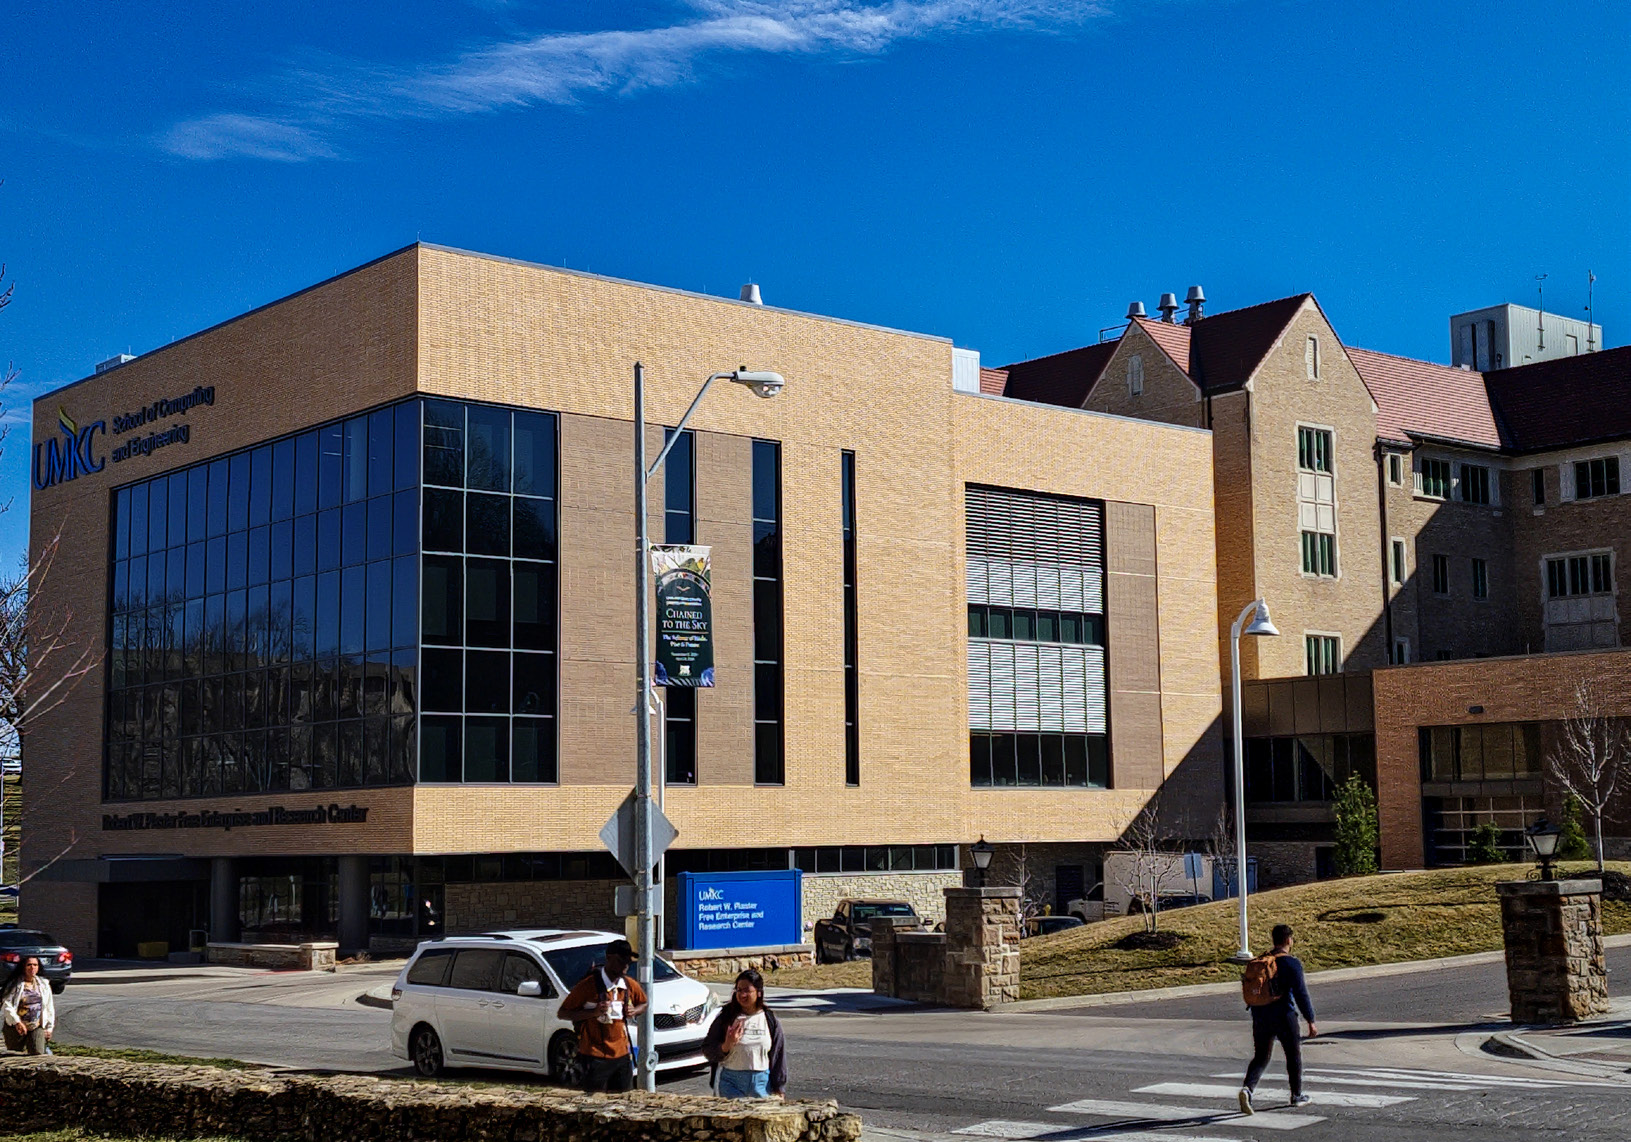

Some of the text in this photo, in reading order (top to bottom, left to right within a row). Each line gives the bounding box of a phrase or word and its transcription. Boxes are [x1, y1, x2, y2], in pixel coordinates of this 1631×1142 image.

[112, 386, 215, 435] School of Computing
[111, 424, 190, 463] and Engineering
[33, 417, 106, 490] UMKC
[273, 804, 326, 824] Research
[327, 803, 369, 823] Center
[699, 888, 724, 901] UMKC
[699, 903, 722, 911] Robert
[734, 902, 757, 910] Plaster
[699, 911, 764, 921] Free Enterprise and
[699, 921, 755, 930] Research Center
